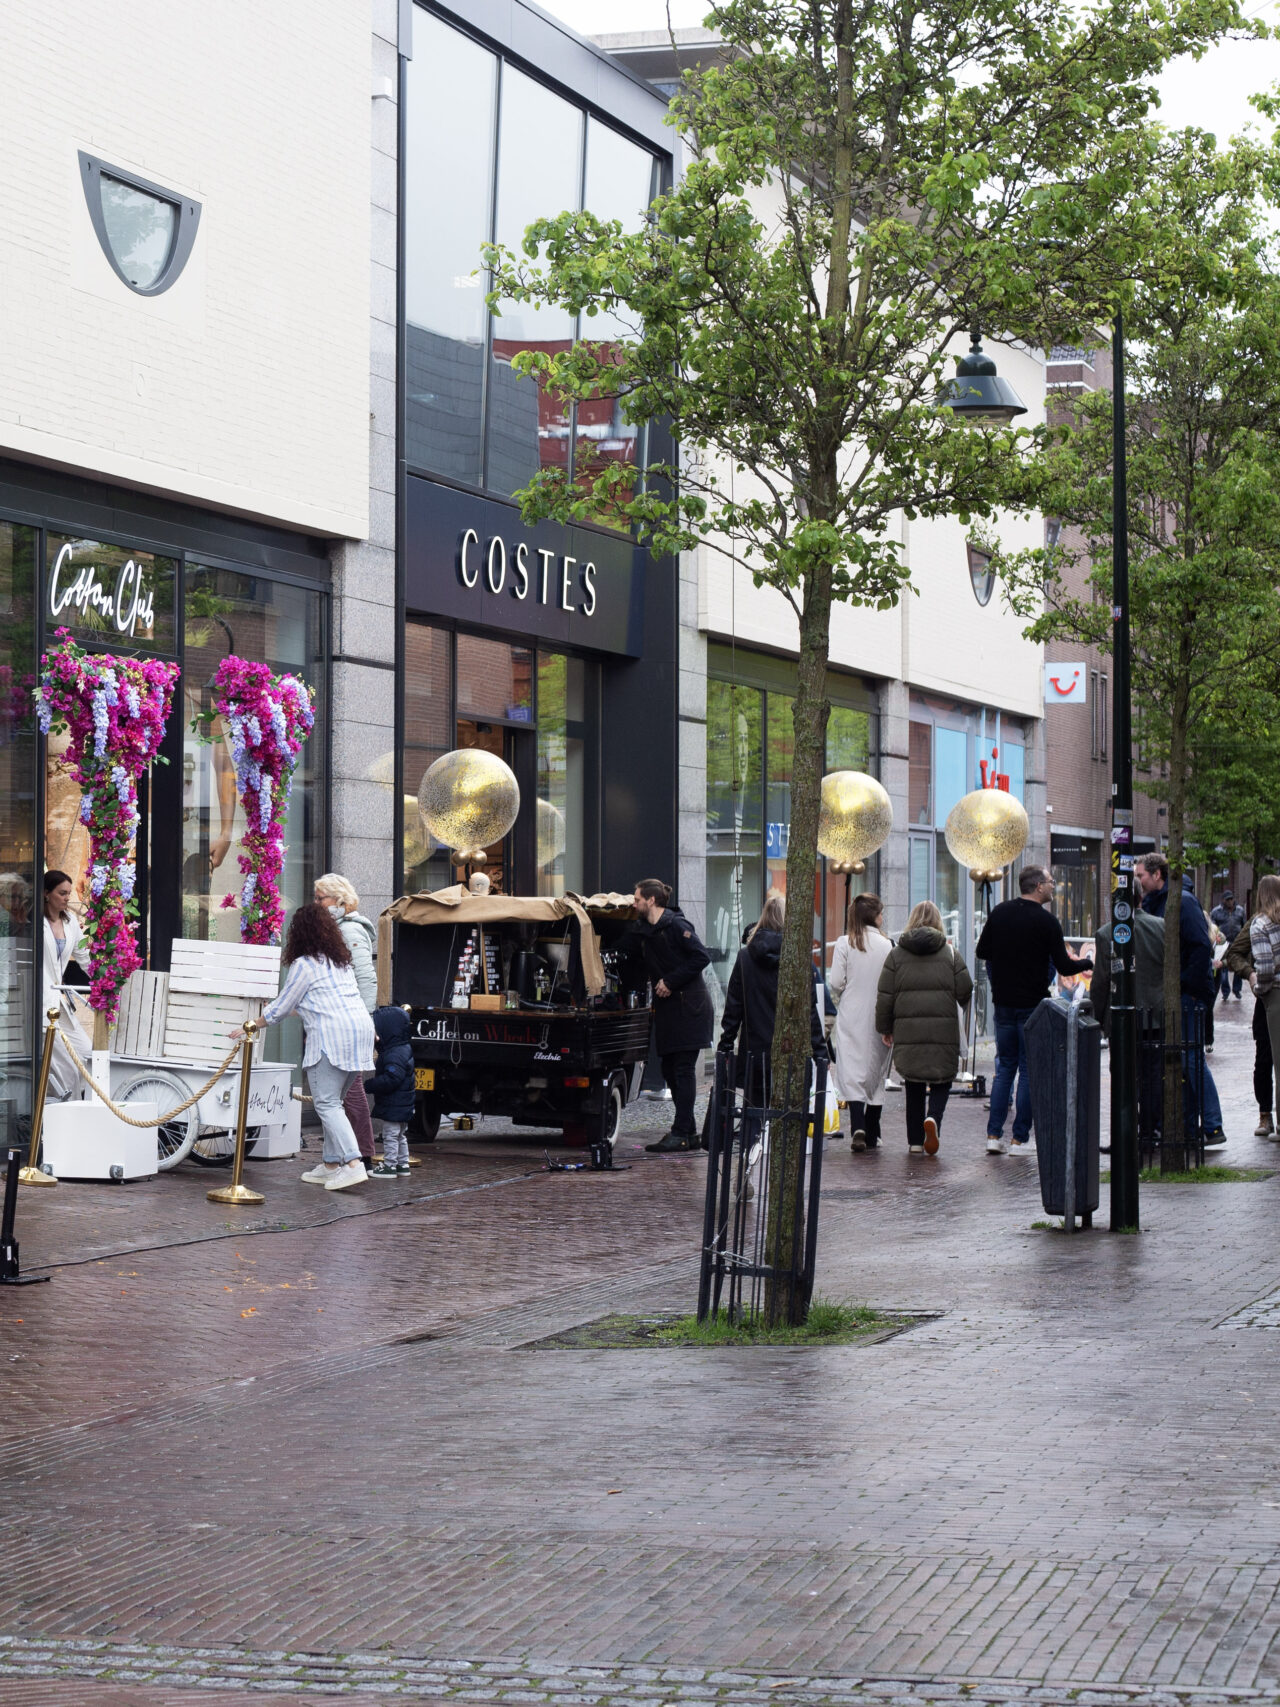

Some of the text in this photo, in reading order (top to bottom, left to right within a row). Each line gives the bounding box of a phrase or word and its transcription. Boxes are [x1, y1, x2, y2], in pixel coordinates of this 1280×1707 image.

[460, 528, 596, 616] COSTES
[50, 543, 154, 637] Cotton Club
[417, 1019, 537, 1043] Coffee on Wheels
[533, 1052, 562, 1061] Electric
[267, 1085, 284, 1115] Club
